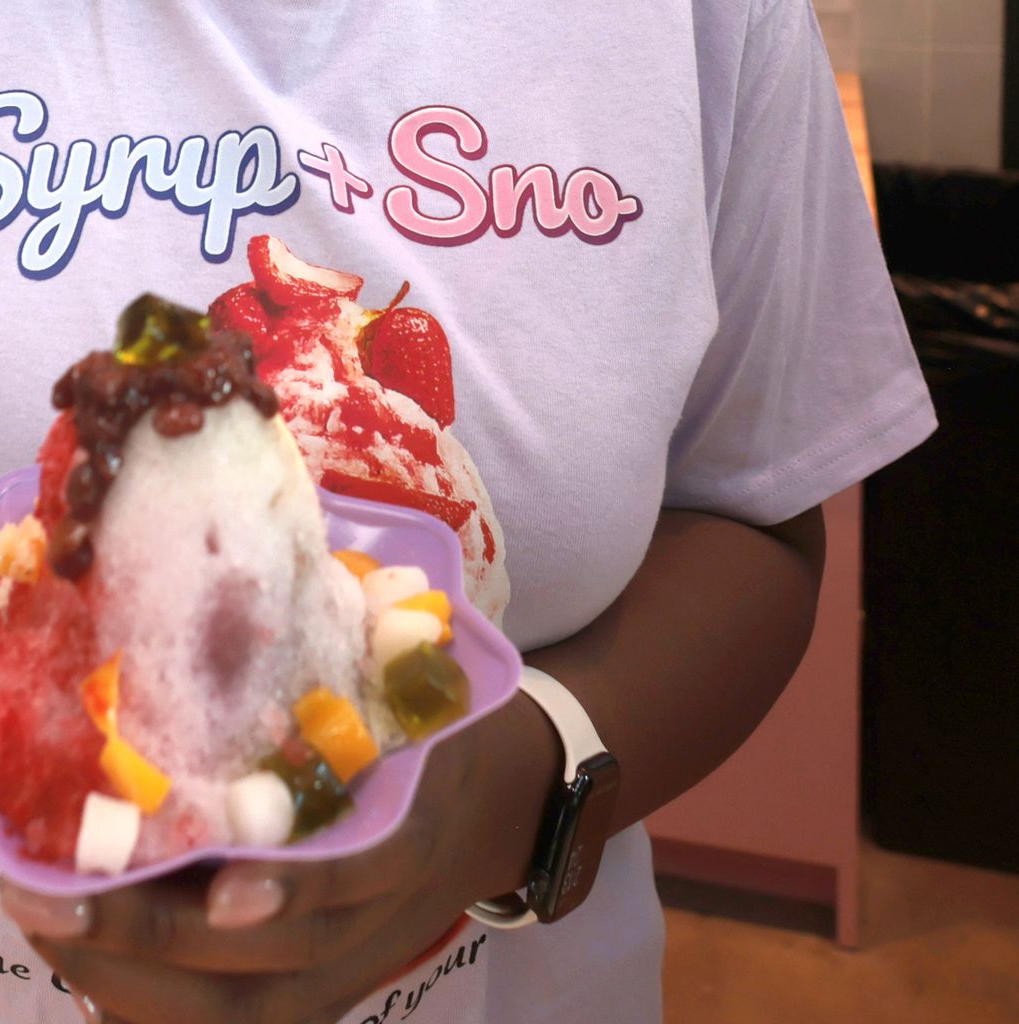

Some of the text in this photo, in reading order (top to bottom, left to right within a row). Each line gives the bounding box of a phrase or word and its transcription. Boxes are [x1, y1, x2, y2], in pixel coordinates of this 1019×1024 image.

[296, 141, 374, 215] +
[382, 104, 642, 246] Sno
[400, 933, 487, 1021] your
